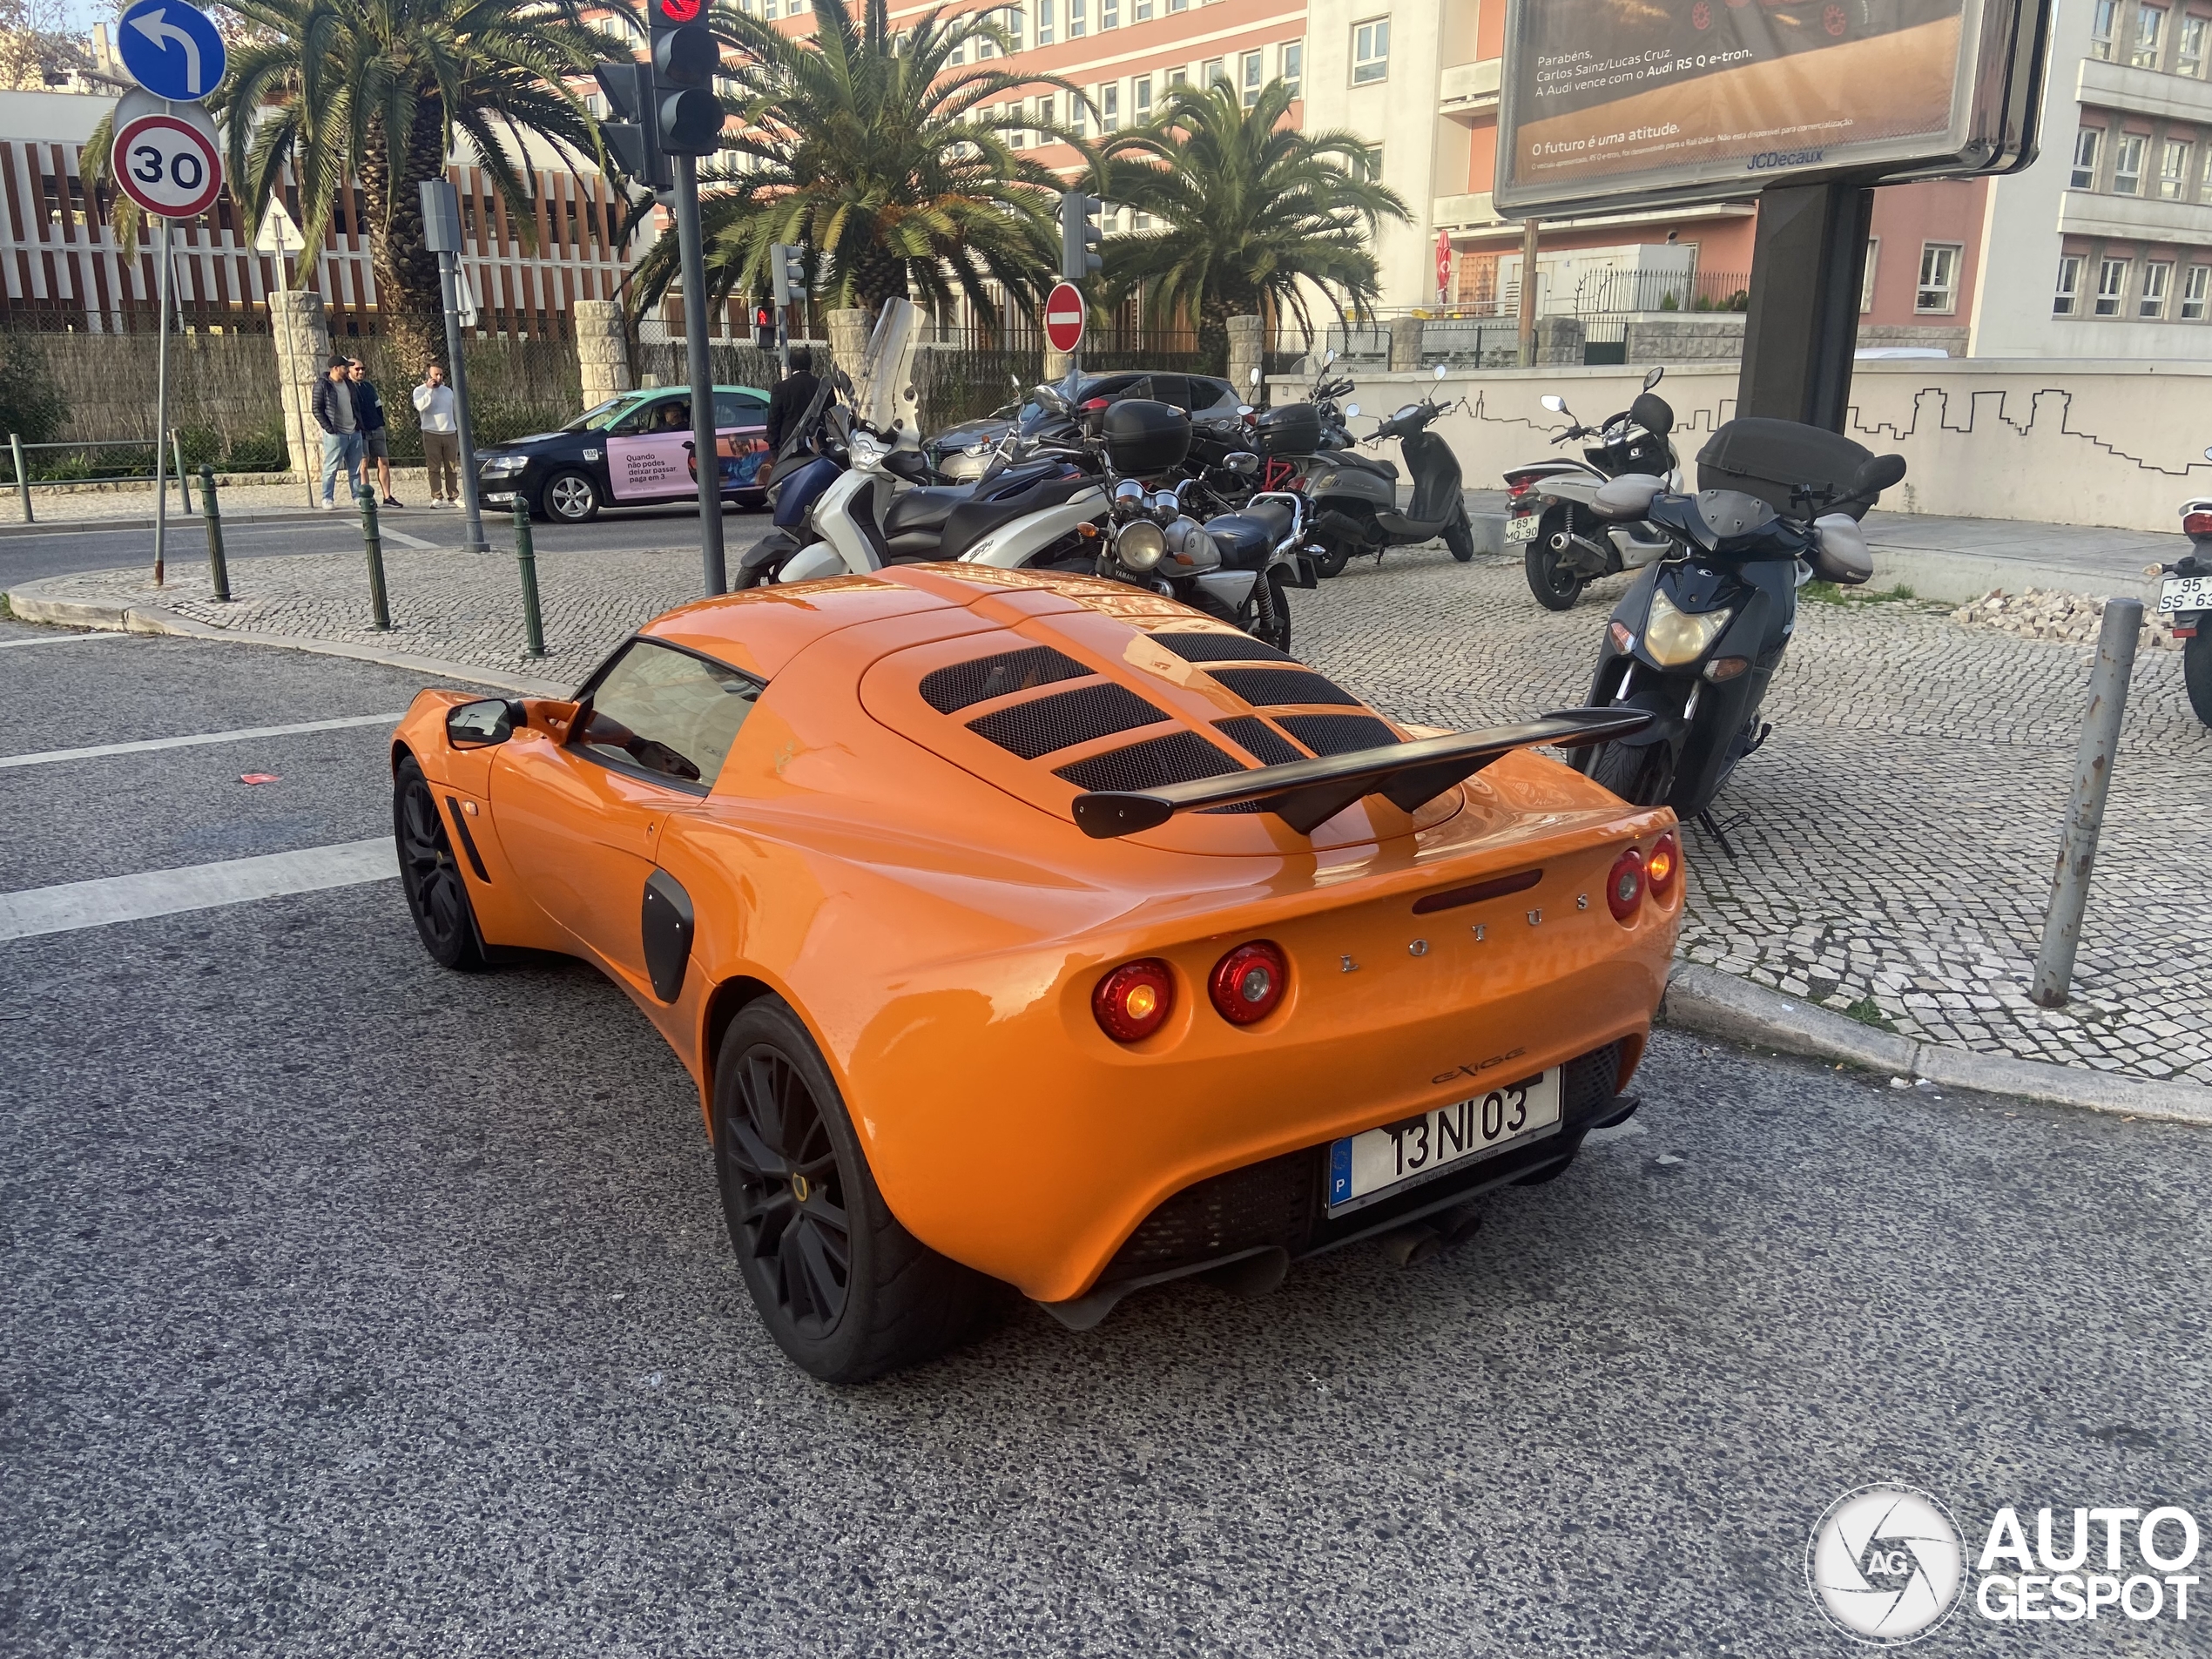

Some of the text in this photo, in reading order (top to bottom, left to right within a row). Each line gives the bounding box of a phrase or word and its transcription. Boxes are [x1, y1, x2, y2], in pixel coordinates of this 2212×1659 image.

[1536, 49, 1673, 83] Carlos Sainz/Lucas Cruz.
[1537, 50, 1594, 68] Parabéns,
[1534, 49, 1753, 98] A Audi vence com o Audi RS Q e-tron.
[1532, 122, 1681, 156] O futuro é uma atitude.
[132, 145, 203, 190] 30
[1746, 150, 1824, 170] JCDecaux
[626, 453, 656, 462] Quando
[643, 459, 665, 469] podes
[629, 475, 647, 484] paga
[1515, 517, 1528, 529] 69
[1114, 569, 1138, 583] YAMAHA
[2181, 577, 2203, 593] 95
[1340, 894, 1588, 973] LOTUS
[1335, 1178, 1345, 1194] P
